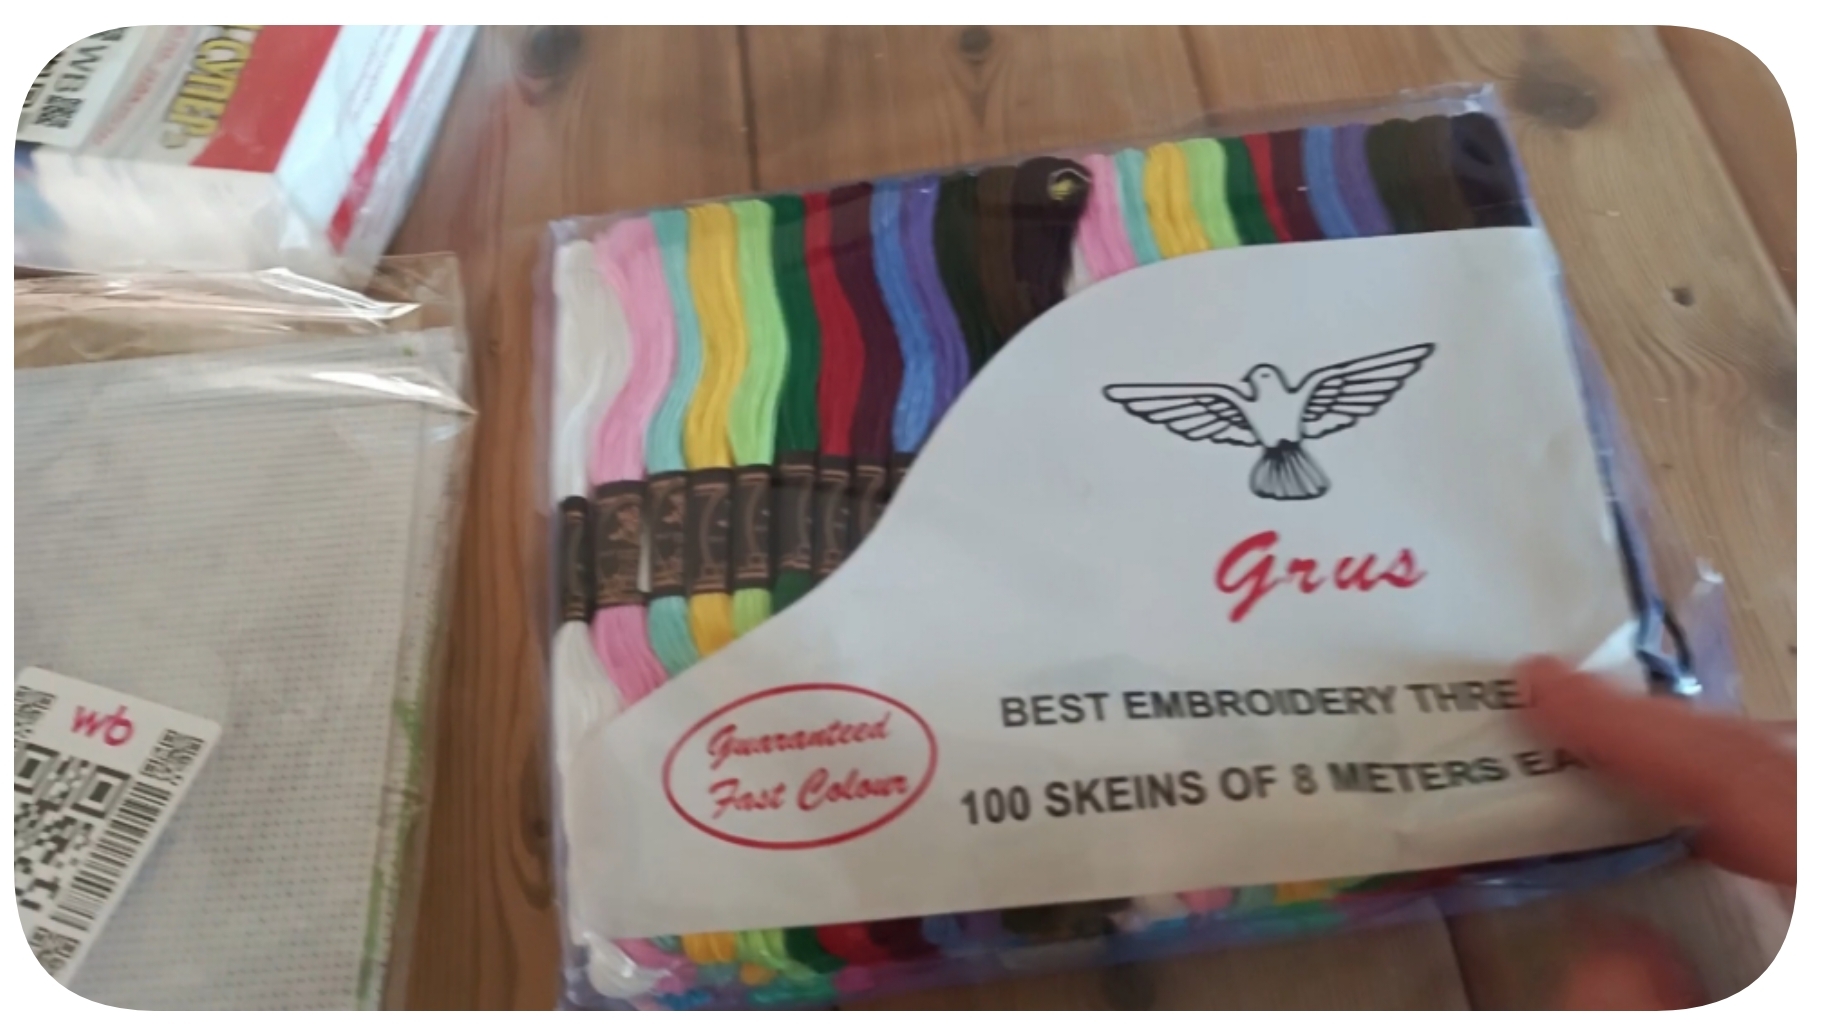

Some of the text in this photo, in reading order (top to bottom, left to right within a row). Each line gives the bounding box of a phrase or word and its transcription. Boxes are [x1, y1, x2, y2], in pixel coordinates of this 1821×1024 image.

[1214, 529, 1428, 623] Grus
[70, 705, 133, 747] wb
[1000, 678, 1536, 728] BEST EMBROIDERY THRE
[707, 711, 892, 770] Guaranteed
[708, 767, 909, 819] Fast Colour
[960, 748, 1590, 825] 100 SKEINS OF 8 METERS EA
